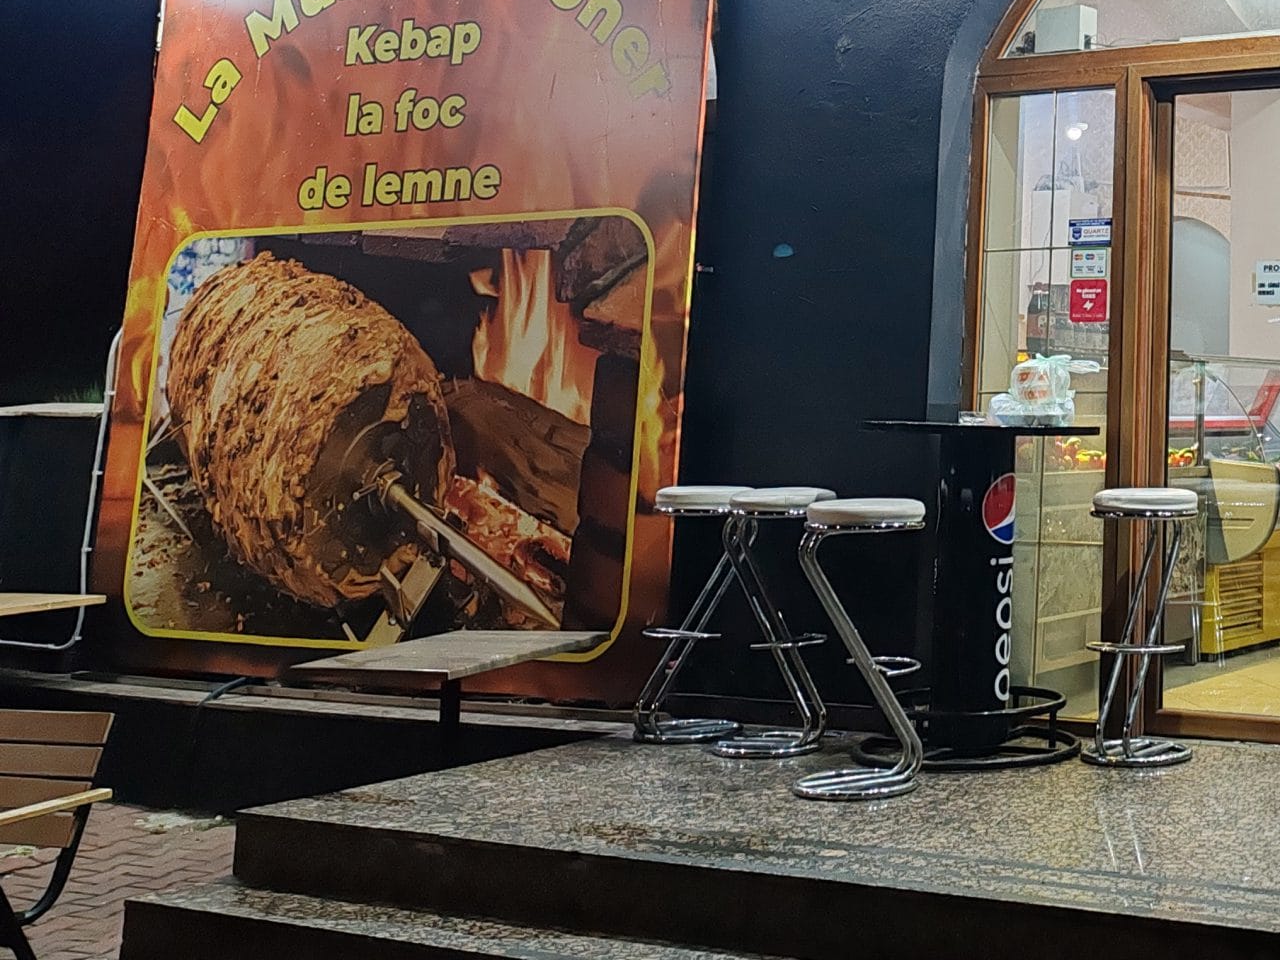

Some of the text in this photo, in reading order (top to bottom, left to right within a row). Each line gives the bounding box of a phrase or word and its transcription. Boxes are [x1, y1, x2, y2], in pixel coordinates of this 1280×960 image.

[344, 17, 482, 66] Kebap
[172, 56, 244, 144] La
[344, 87, 466, 136] la foc
[297, 164, 502, 210] de lemne
